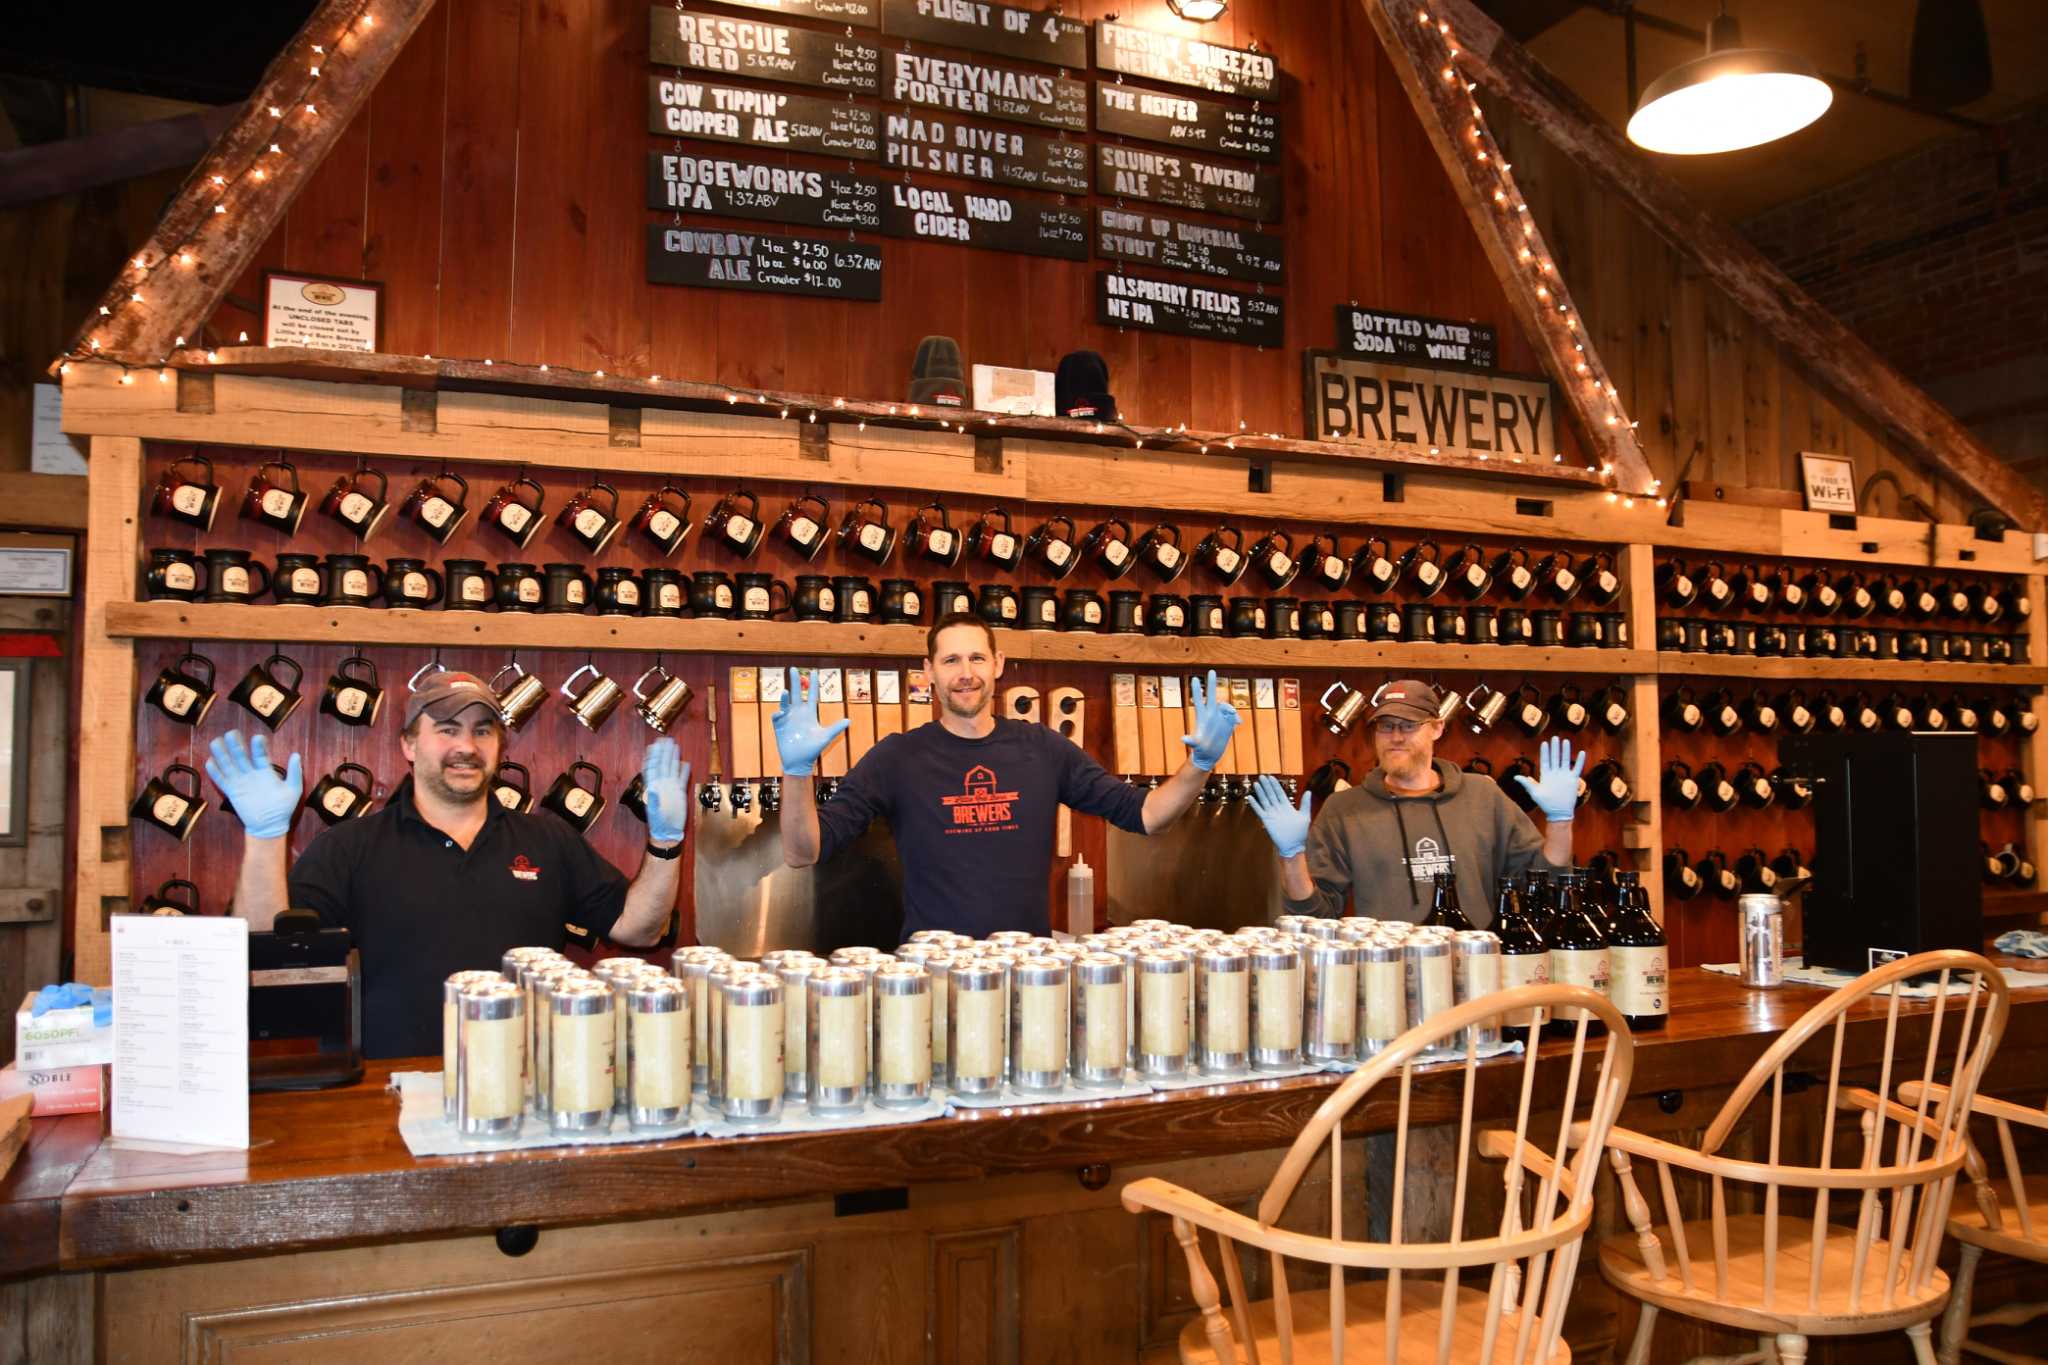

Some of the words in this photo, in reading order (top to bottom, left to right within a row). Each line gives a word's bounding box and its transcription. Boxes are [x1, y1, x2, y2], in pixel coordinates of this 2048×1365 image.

[678, 15, 791, 56] RESCUE
[917, 0, 990, 27] FLIGHT
[1004, 9, 1031, 35] OF
[1042, 18, 1060, 43] 4
[689, 43, 739, 71] RED
[896, 53, 1054, 105] EVERYMAN'S
[659, 81, 703, 108] COW
[711, 88, 787, 117] TIPPIN'
[894, 78, 990, 113] PORTER
[1102, 88, 1136, 112] THE
[1140, 94, 1199, 122] HEIFER
[666, 108, 740, 138] COPPER
[752, 118, 790, 143] ALE
[888, 116, 944, 144] MAD
[955, 126, 1024, 156] RIVER
[887, 142, 994, 179] PILSNER
[1102, 147, 1181, 178] SQUIRE'S
[1190, 162, 1256, 193] TAVERN
[662, 155, 823, 198] EDGEWORKS
[1114, 171, 1150, 197] ALE
[667, 181, 713, 210] IPA
[894, 184, 954, 214] LOCAL
[964, 194, 1013, 222] HARD
[914, 212, 971, 241] CIDER
[1177, 222, 1245, 251] IMPERIAL
[664, 230, 756, 257] COWBOY
[1102, 233, 1157, 258] STOUT
[708, 258, 752, 282] ALE
[758, 271, 801, 287] Crowler
[1107, 274, 1188, 307] RASPBERRY
[1192, 288, 1241, 316] FIELDS
[288, 314, 331, 324] UNCLOSED
[1107, 298, 1130, 319] NE
[1132, 302, 1155, 324] IPA
[1352, 311, 1422, 337] BOTTLED
[1424, 322, 1471, 344] WATER
[1353, 331, 1396, 353] SODA
[1426, 344, 1467, 361] WINE
[1320, 372, 1547, 456] BREWERY
[1810, 484, 1851, 501] Wi-Fi
[952, 802, 1013, 824] BREWERS
